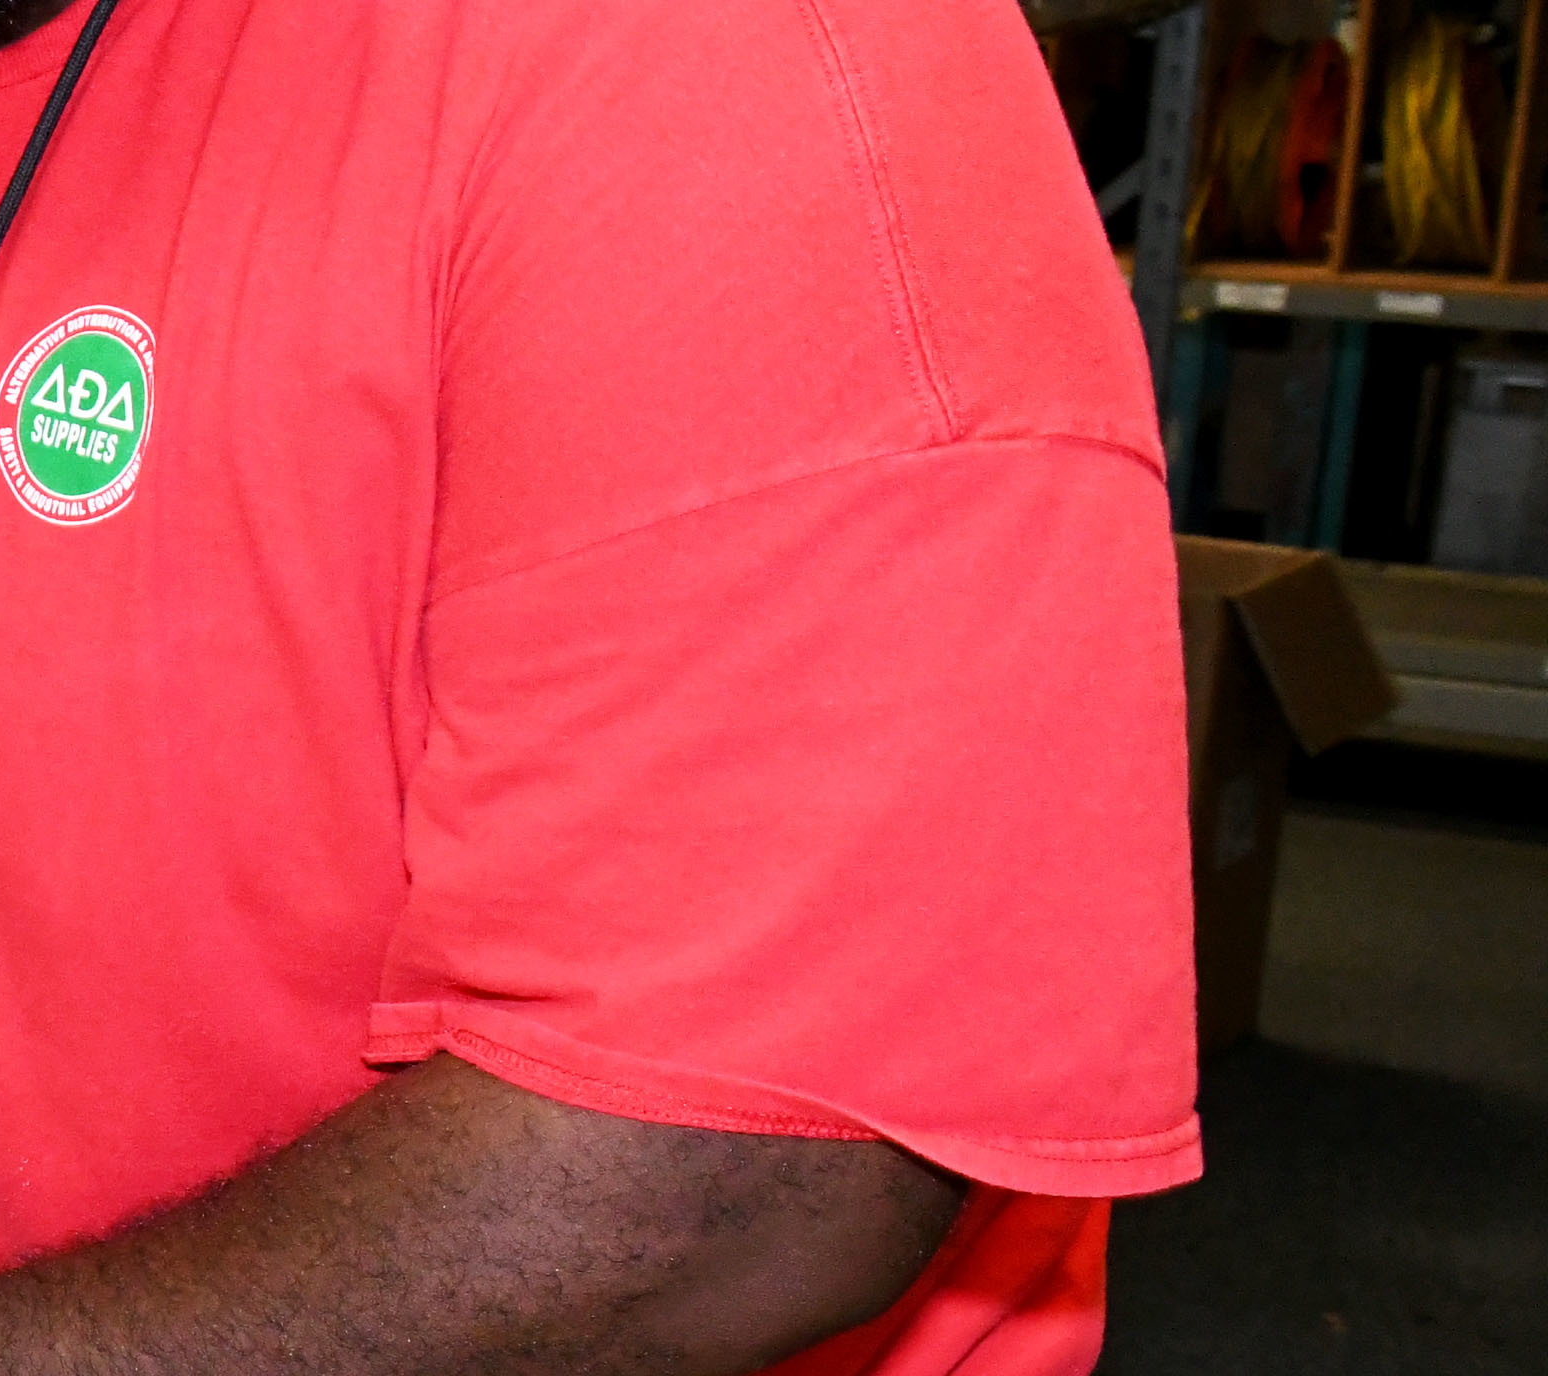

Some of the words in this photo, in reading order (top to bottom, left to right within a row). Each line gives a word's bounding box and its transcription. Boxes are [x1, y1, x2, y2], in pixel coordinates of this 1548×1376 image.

[67, 313, 143, 343] DISTRIBUTION
[30, 413, 119, 464] SUPPLIES
[21, 481, 86, 516] INDUSTRIAL
